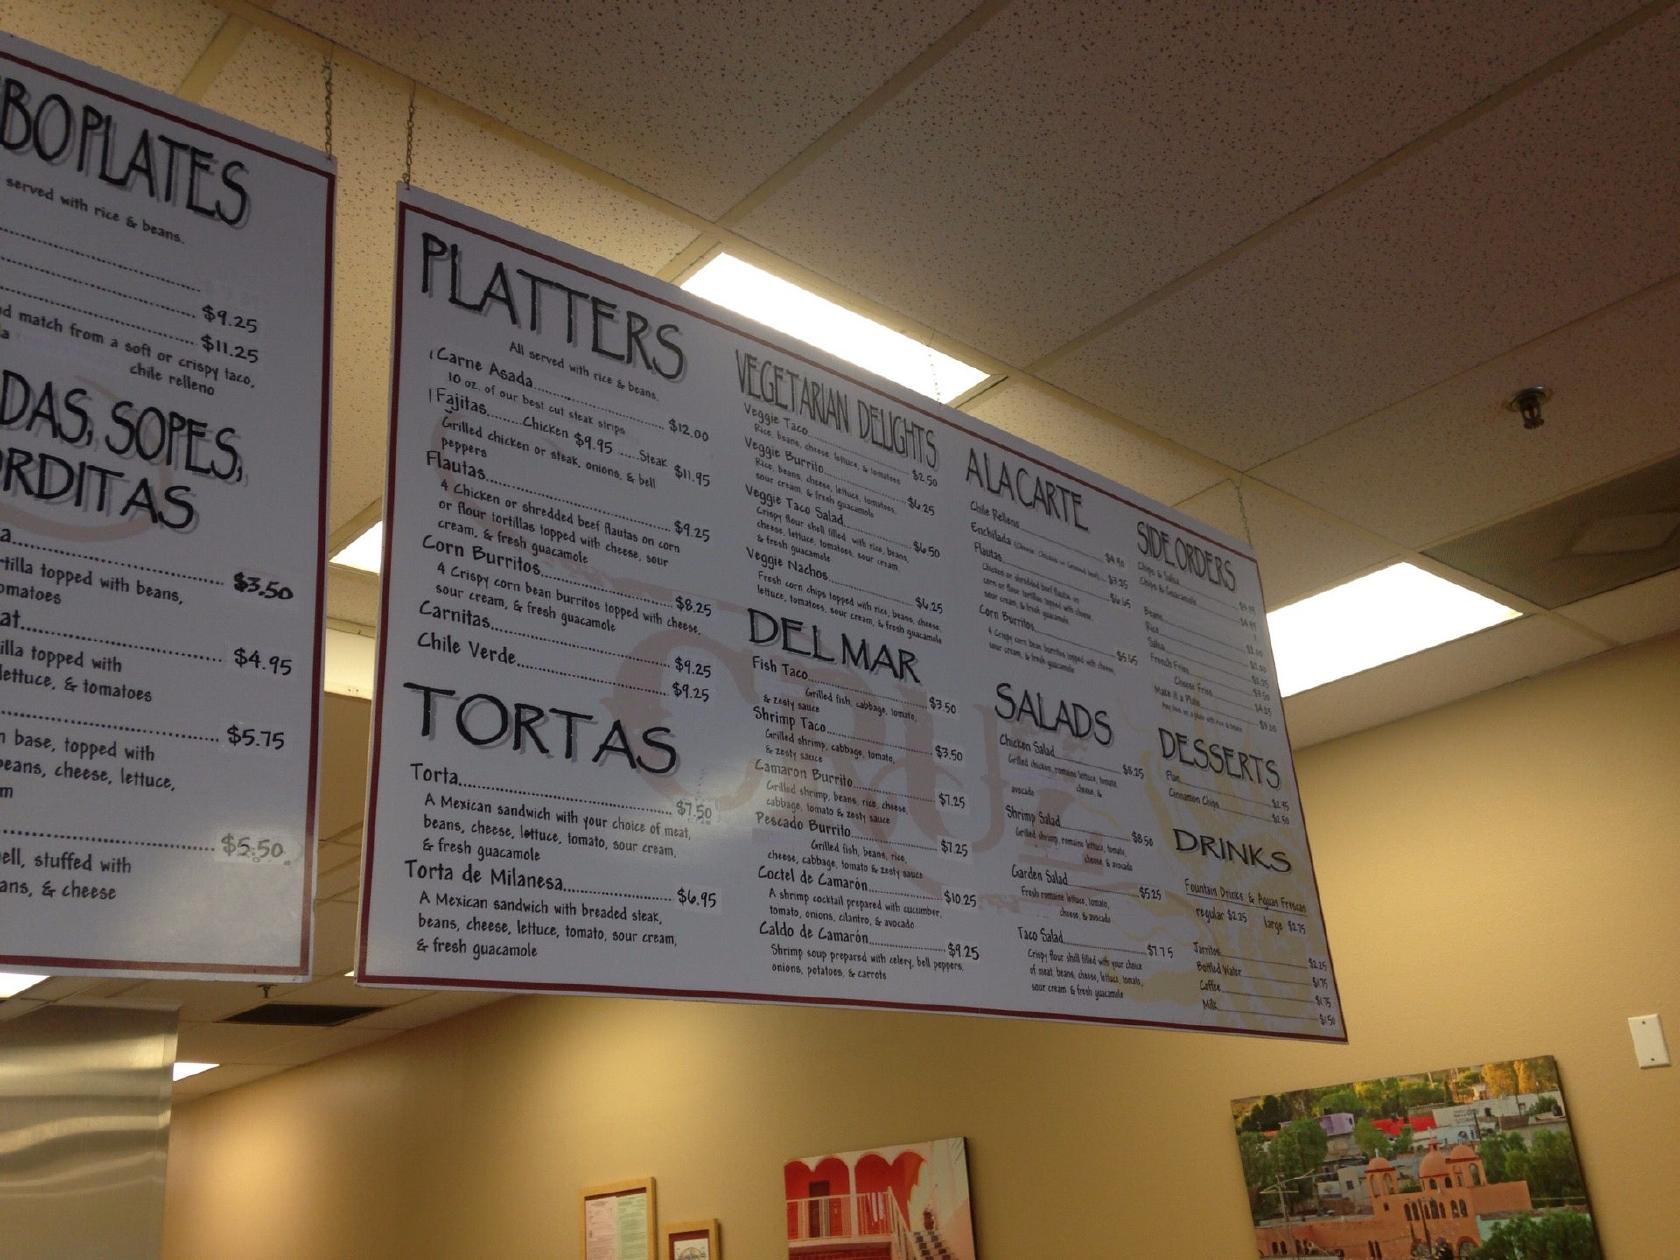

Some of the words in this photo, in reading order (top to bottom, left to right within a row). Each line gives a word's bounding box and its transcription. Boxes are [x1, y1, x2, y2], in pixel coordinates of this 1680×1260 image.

[6, 177, 54, 201] served
[60, 195, 88, 212] with
[94, 206, 120, 222] rice
[125, 216, 138, 229] &
[142, 219, 185, 243] beans.
[201, 304, 257, 333] $9.25
[421, 231, 684, 380] PLATTERS
[18, 311, 63, 333] match
[69, 322, 104, 344] from
[109, 338, 118, 348] a
[124, 342, 151, 357] soft
[156, 352, 173, 363] or
[178, 358, 219, 381] crispy
[224, 367, 255, 388] taco,
[200, 333, 258, 363] $11.25
[129, 362, 162, 381] chile
[169, 374, 214, 396] relleno
[509, 341, 524, 356] All
[529, 351, 564, 369] served
[568, 364, 589, 377] with
[593, 372, 612, 384] rice
[616, 379, 625, 390] &
[627, 380, 660, 401] beans.
[436, 346, 482, 371] Carne
[489, 362, 533, 388] Asada
[668, 418, 709, 442] $12.00
[735, 349, 849, 433] VEGETARIAN
[857, 399, 937, 469] DELIGHTS
[436, 387, 487, 415] Fajitas
[522, 416, 568, 439] Chicken
[574, 431, 612, 454] $9.95
[639, 449, 668, 467] Steak
[673, 464, 710, 487] $11.95
[743, 402, 779, 426] Veggie
[782, 417, 808, 436] Taco
[104, 400, 243, 482] SOPES,
[744, 436, 780, 460] Veggie
[784, 450, 824, 473] Burrito
[0, 447, 194, 529] RDITAS
[426, 450, 486, 480] Flautas
[673, 520, 710, 543] $9.25
[745, 483, 782, 508] Veggie
[785, 497, 810, 515] Taco
[814, 506, 844, 526] Salad
[422, 534, 464, 557] Corn
[472, 545, 541, 575] Burritos
[675, 595, 711, 617] $8.25
[746, 546, 783, 570] Veggie
[787, 560, 828, 581] Nachos
[40, 563, 92, 587] topped
[100, 576, 129, 592] with
[136, 579, 183, 605] beans,
[233, 571, 294, 600] $3.50
[419, 599, 490, 628] Carnitas
[674, 655, 711, 678] $9.25
[31, 645, 84, 669] topped
[91, 656, 122, 672] with
[233, 646, 292, 676] $4.95
[417, 631, 460, 654] Chile
[468, 640, 516, 664] Verde
[671, 680, 709, 702] $9.25
[752, 655, 777, 673] Fish
[781, 663, 808, 680] Taco
[0, 663, 55, 690] lettuce,
[63, 676, 78, 692] &
[82, 678, 152, 702] tomatoes
[403, 681, 677, 774] TORTAS
[752, 705, 795, 731] Shrimp
[799, 716, 826, 732] Taco
[994, 682, 1112, 746] SALADS
[14, 728, 55, 752] base,
[64, 737, 117, 760] topped
[124, 744, 155, 761] with
[226, 724, 284, 750] $5.75
[999, 733, 1031, 752] Chicken
[54, 760, 112, 785] cheese,
[120, 767, 175, 791] lettuce,
[410, 762, 458, 785] Torta
[675, 799, 712, 820] $7.50
[754, 758, 807, 780] Camaron
[811, 768, 853, 788] Burrito
[424, 792, 436, 806] A
[440, 795, 491, 813] Mexican
[497, 803, 550, 820] sandwich
[555, 809, 578, 824] with
[582, 816, 608, 830] your
[611, 815, 646, 832] choice
[649, 821, 661, 835] of
[664, 827, 691, 841] meat,
[808, 819, 851, 837] Burrito
[34, 851, 92, 871] stuffed
[100, 856, 131, 873] with
[220, 832, 284, 858] $5.50
[41, 880, 56, 898] &
[61, 880, 116, 900] cheese
[404, 859, 453, 880] Torta
[462, 863, 482, 883] de
[490, 867, 563, 891] Milanesa
[676, 887, 716, 908] $6.95
[758, 865, 795, 882] Coctel
[799, 869, 813, 884] de
[759, 920, 794, 937] Caldo
[799, 923, 813, 939] de
